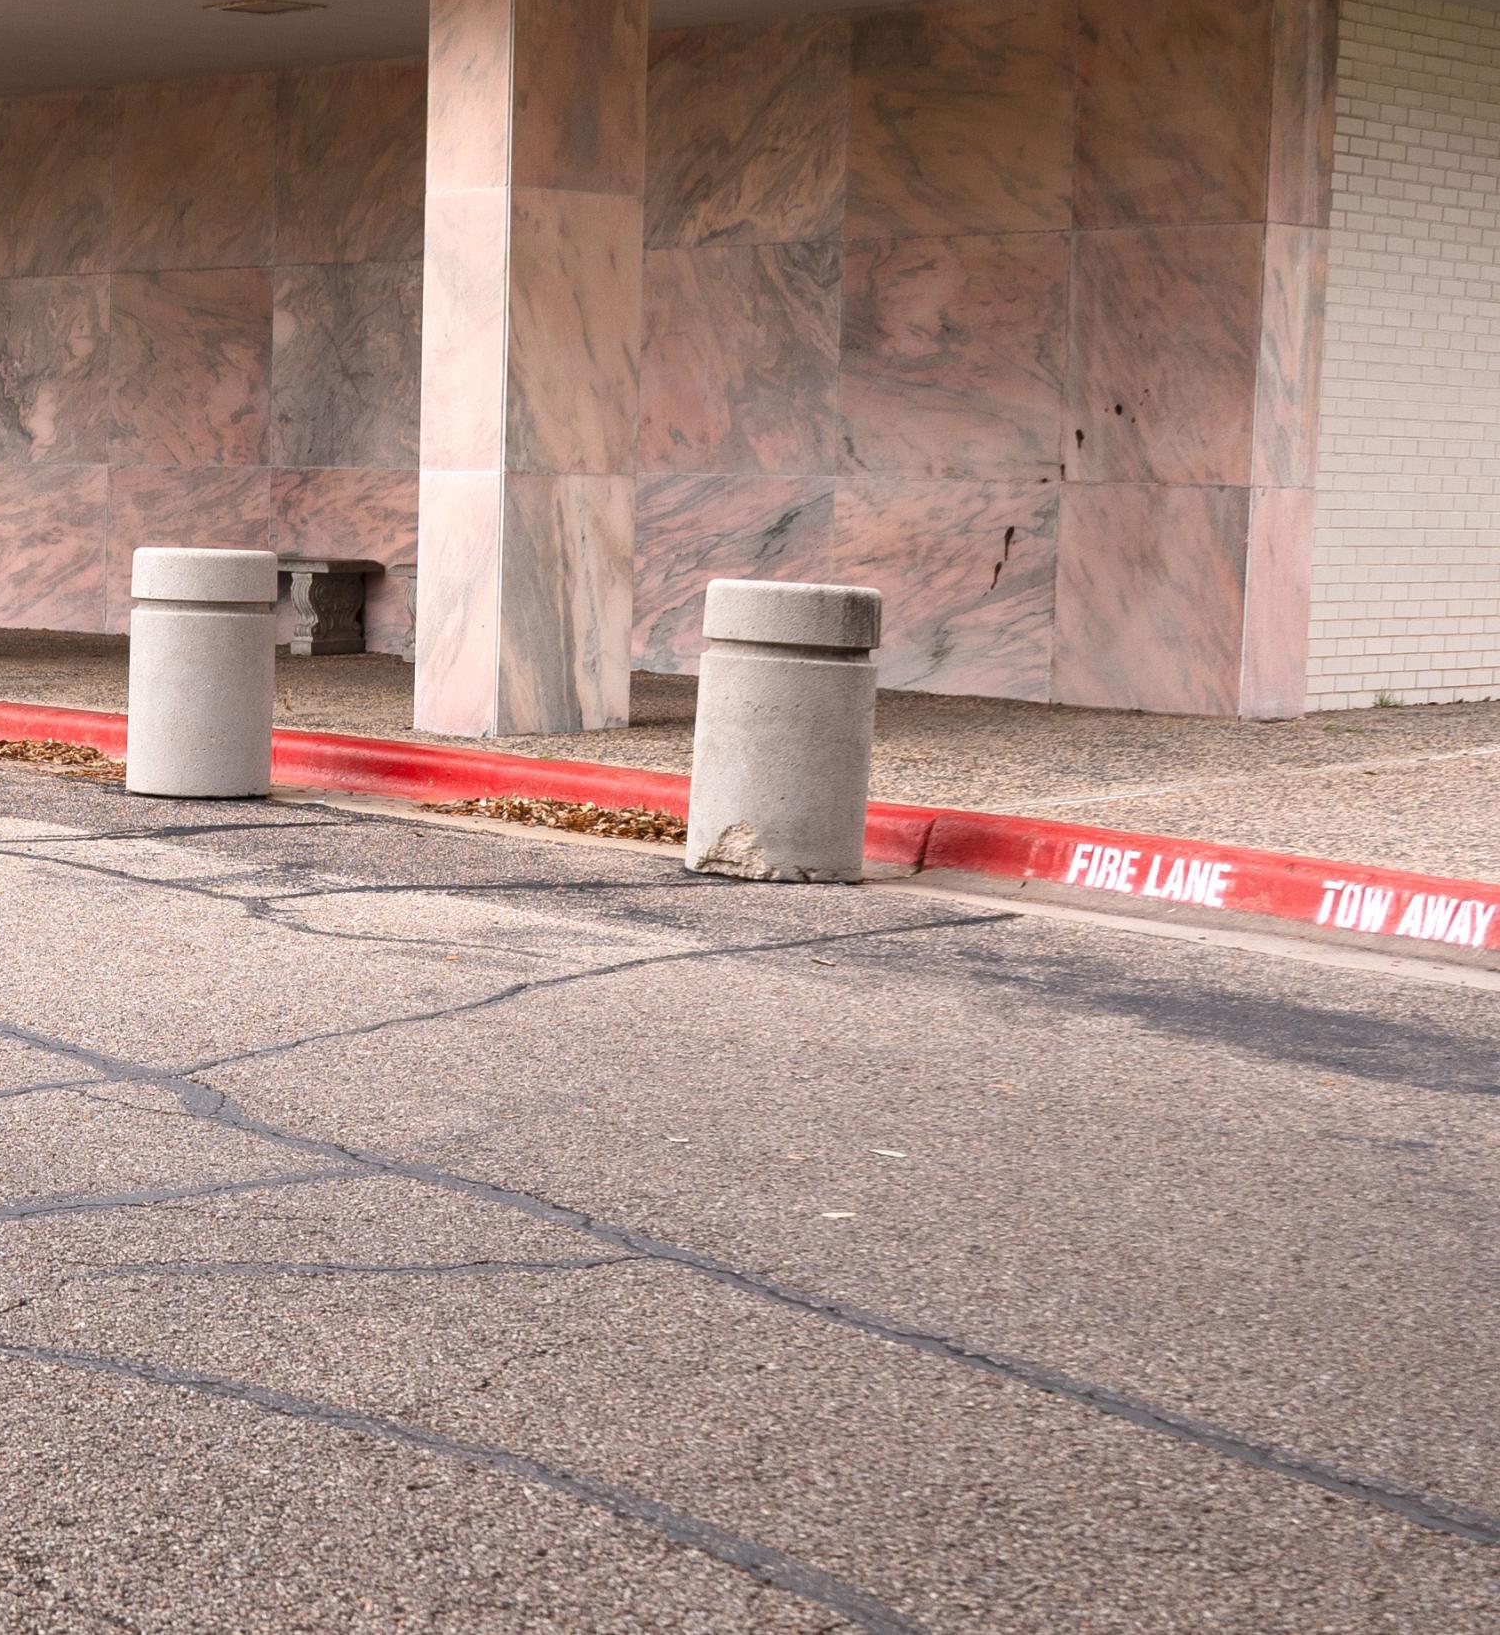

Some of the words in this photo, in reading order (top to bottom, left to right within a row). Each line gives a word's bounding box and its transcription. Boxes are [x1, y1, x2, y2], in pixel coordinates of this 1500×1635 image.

[1066, 843, 1141, 893] FIRE
[1143, 854, 1232, 908] LANE
[1316, 880, 1394, 932] TOW
[1395, 893, 1496, 948] AWAY
